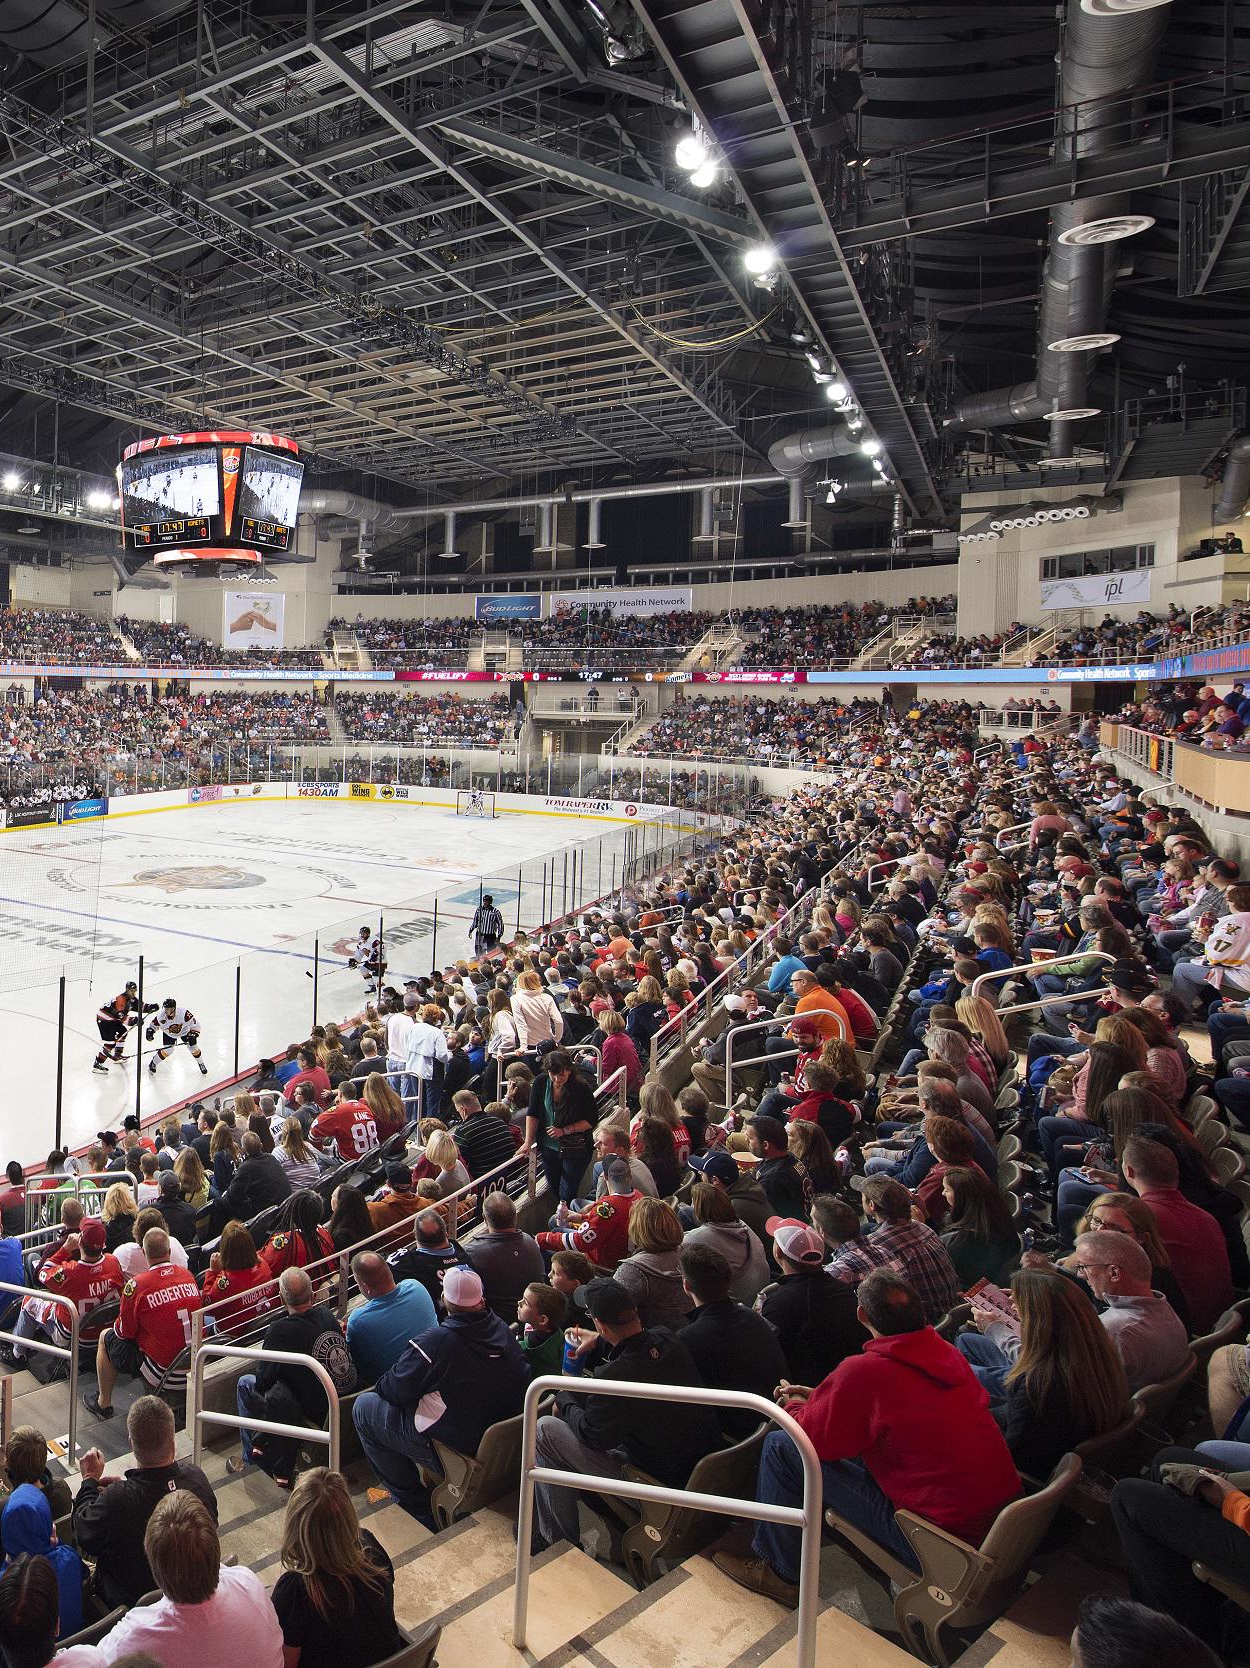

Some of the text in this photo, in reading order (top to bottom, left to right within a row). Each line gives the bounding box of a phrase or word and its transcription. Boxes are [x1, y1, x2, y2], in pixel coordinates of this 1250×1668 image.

[161, 521, 183, 533] 17:47
[1105, 578, 1123, 602] ipl
[486, 604, 536, 613] BUD LIGHT
[570, 597, 686, 610] Community Health Network
[230, 671, 262, 681] Community
[263, 671, 285, 681] Health
[317, 672, 340, 682] Sports
[342, 672, 374, 681] Medicine
[422, 672, 469, 681] #FUELIFY
[532, 673, 540, 681] 0
[645, 673, 652, 681] 0
[1057, 671, 1085, 681] Community
[1085, 668, 1104, 679] Health
[1104, 667, 1131, 679] Network
[298, 789, 339, 797] 1430AM
[83, 805, 102, 813] LIGHT
[565, 800, 596, 809] RAPER
[595, 800, 615, 811] RV
[98, 895, 293, 911] FAIRGROUNDS
[27, 929, 169, 973] Network
[1213, 939, 1232, 953] 17
[353, 1111, 371, 1121] KANE
[350, 1120, 380, 1154] 88
[672, 1129, 690, 1143] HULL
[577, 1221, 598, 1244] 88
[88, 1279, 113, 1297] KANE
[147, 1283, 199, 1308] ROBERTSON
[933, 1590, 945, 1602] D
